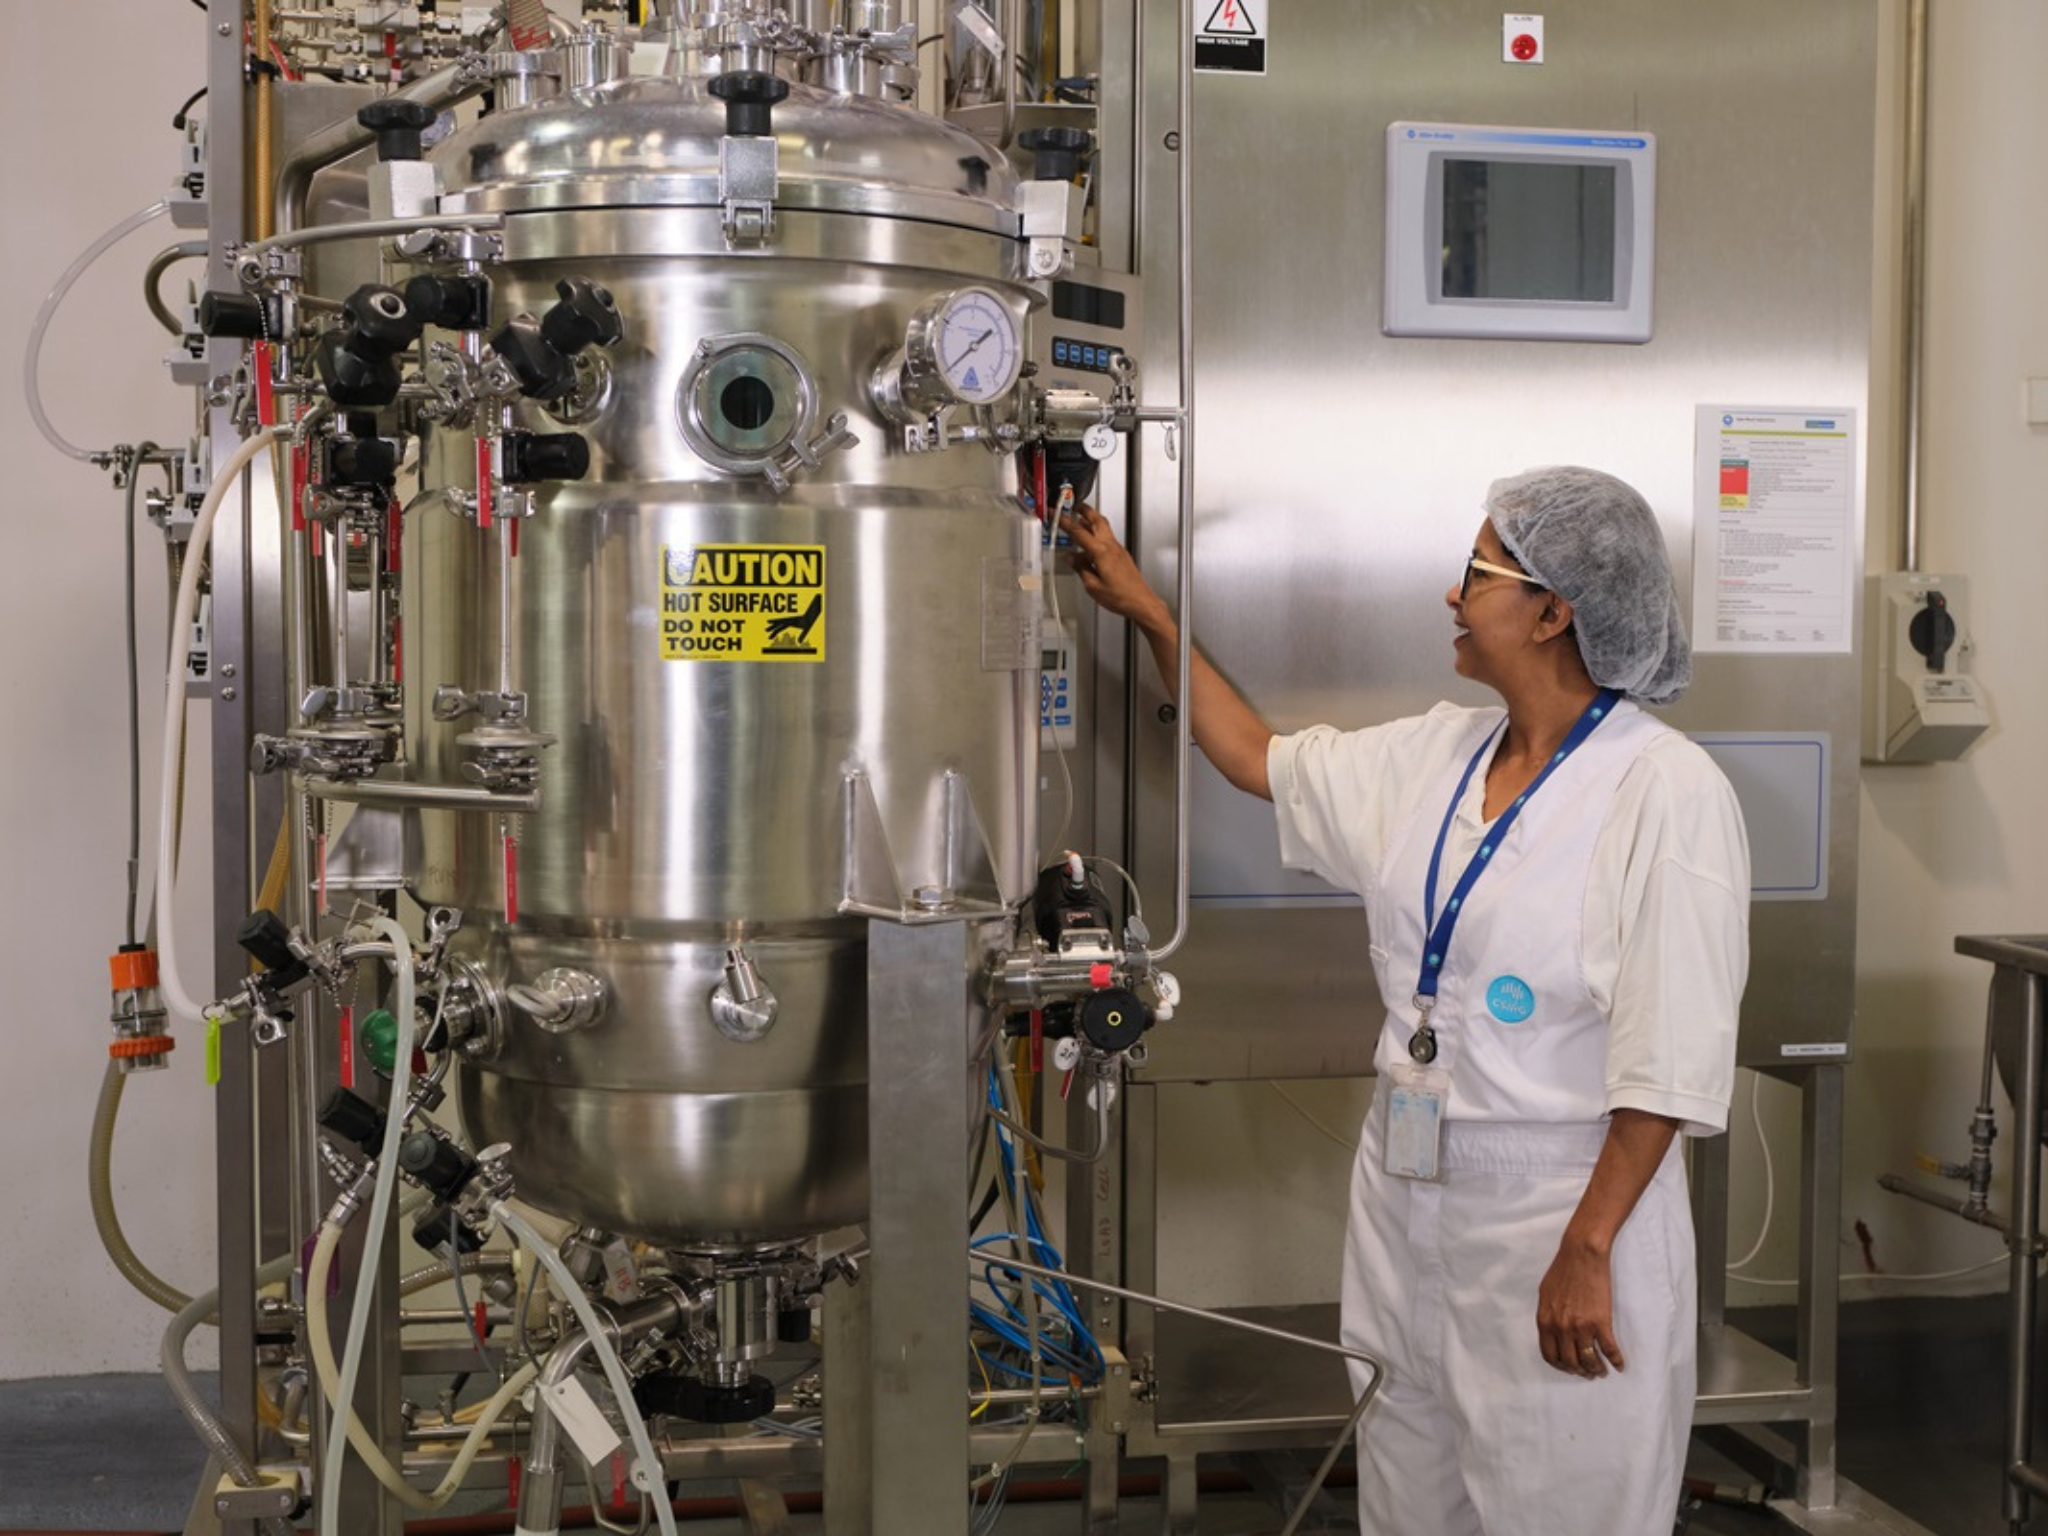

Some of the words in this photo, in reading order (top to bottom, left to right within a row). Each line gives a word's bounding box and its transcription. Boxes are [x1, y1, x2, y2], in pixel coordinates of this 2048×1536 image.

[1216, 38, 1250, 47] VOLTAGE
[667, 552, 818, 586] CAUTION
[664, 592, 702, 613] HOT
[708, 592, 799, 614] SURFACE
[664, 619, 694, 633] DO
[700, 619, 746, 633] NOT
[666, 637, 743, 652] TOUCH
[1492, 997, 1528, 1016] CSIRO
